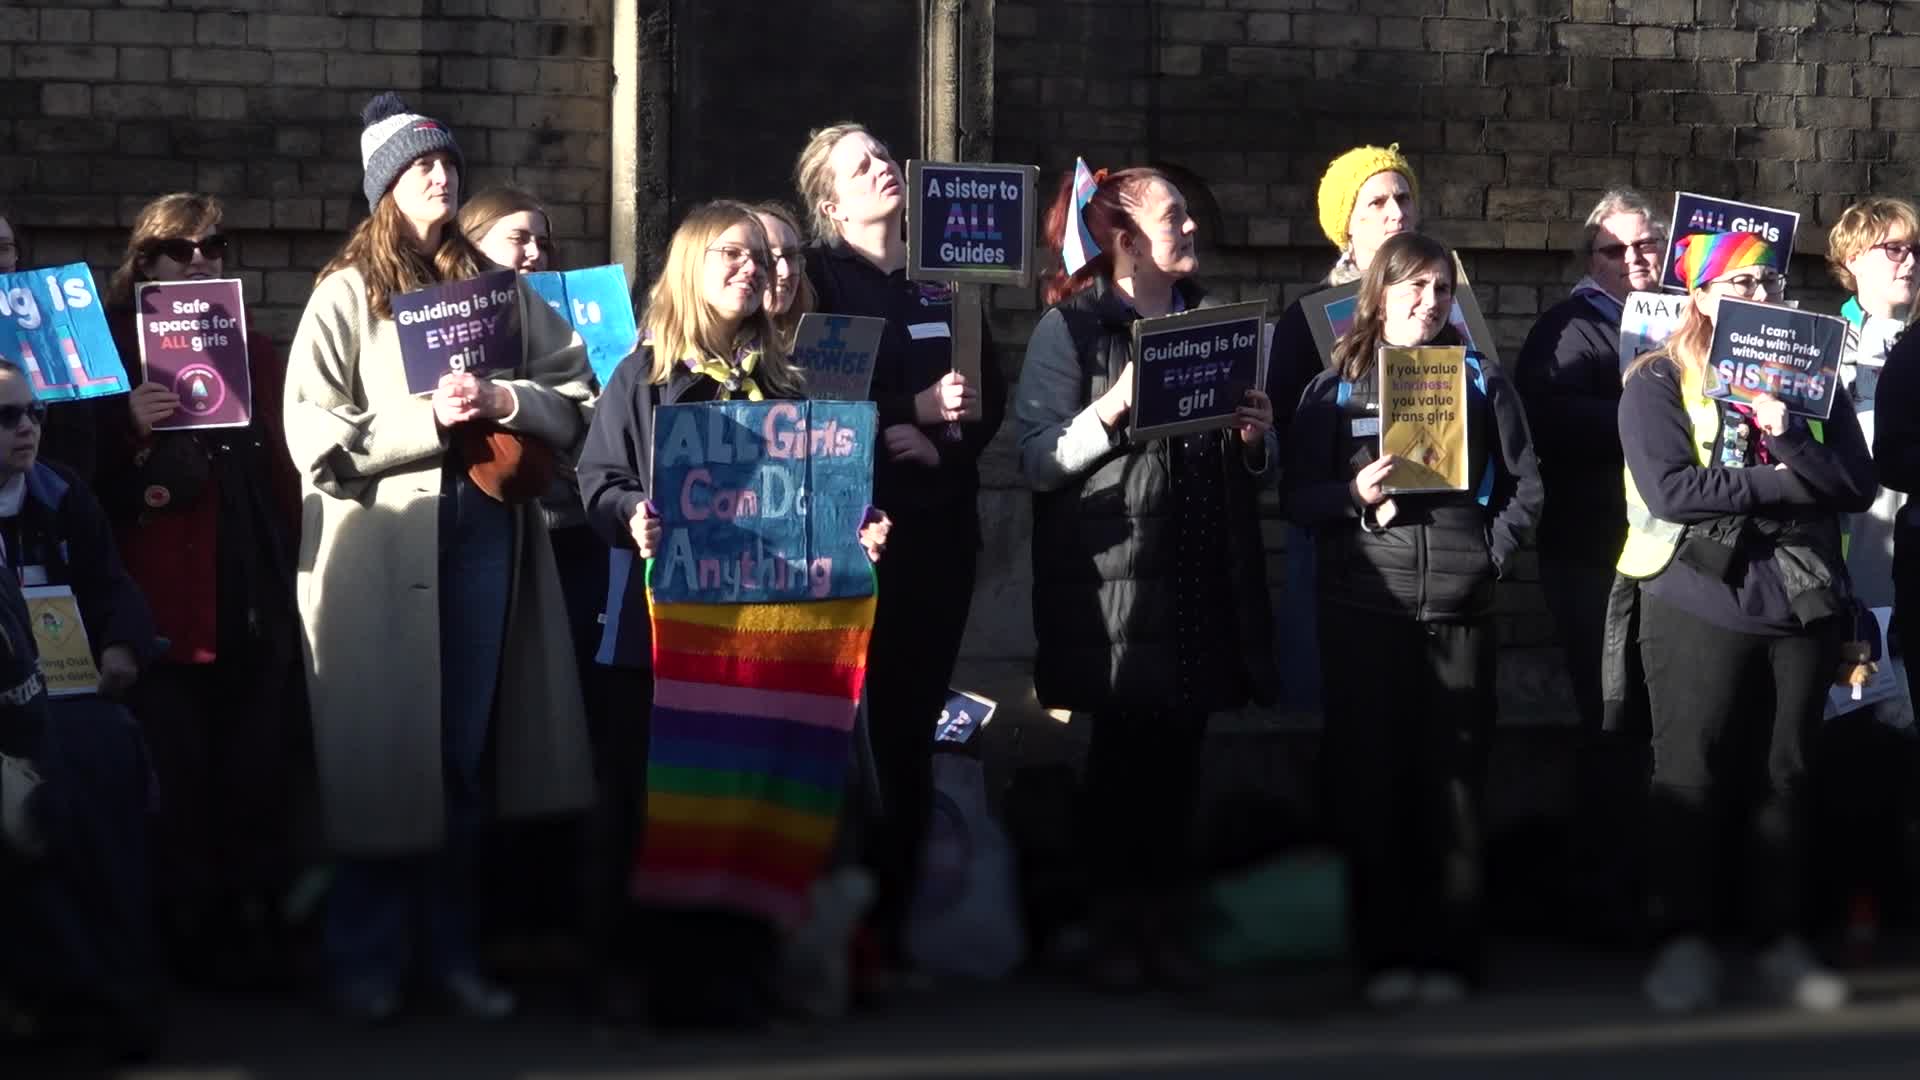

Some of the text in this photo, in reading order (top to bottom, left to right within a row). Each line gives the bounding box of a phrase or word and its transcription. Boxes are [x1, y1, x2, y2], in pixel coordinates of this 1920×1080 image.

[927, 176, 1018, 200] A sister to
[943, 202, 1002, 240] ALL
[1688, 208, 1780, 242] ALL Girls
[940, 241, 1005, 263] Guides
[46, 275, 92, 311] is
[172, 299, 210, 314] Safe
[399, 287, 515, 326] Guiding is for
[149, 315, 236, 336] spaces for
[572, 298, 601, 325] to
[160, 333, 228, 352] ALL girls
[425, 316, 498, 350] EVERY
[1729, 332, 1821, 357] Guide with Pride
[1760, 324, 1796, 340] I can't
[449, 344, 486, 375] girl
[1143, 332, 1256, 362] Guiding is for
[1732, 345, 1812, 371] without all my
[16, 324, 123, 401] LL
[1163, 360, 1233, 387] EVERY
[1397, 366, 1420, 378] you
[1423, 363, 1458, 375] value
[1718, 358, 1826, 401] SISTERS
[1178, 388, 1215, 417] girl
[1392, 396, 1415, 409] you
[1418, 394, 1453, 407] value
[1392, 408, 1455, 425] trans girls
[660, 402, 856, 467] ALL Girls
[680, 468, 758, 521] Can
[660, 527, 833, 601] Anything
